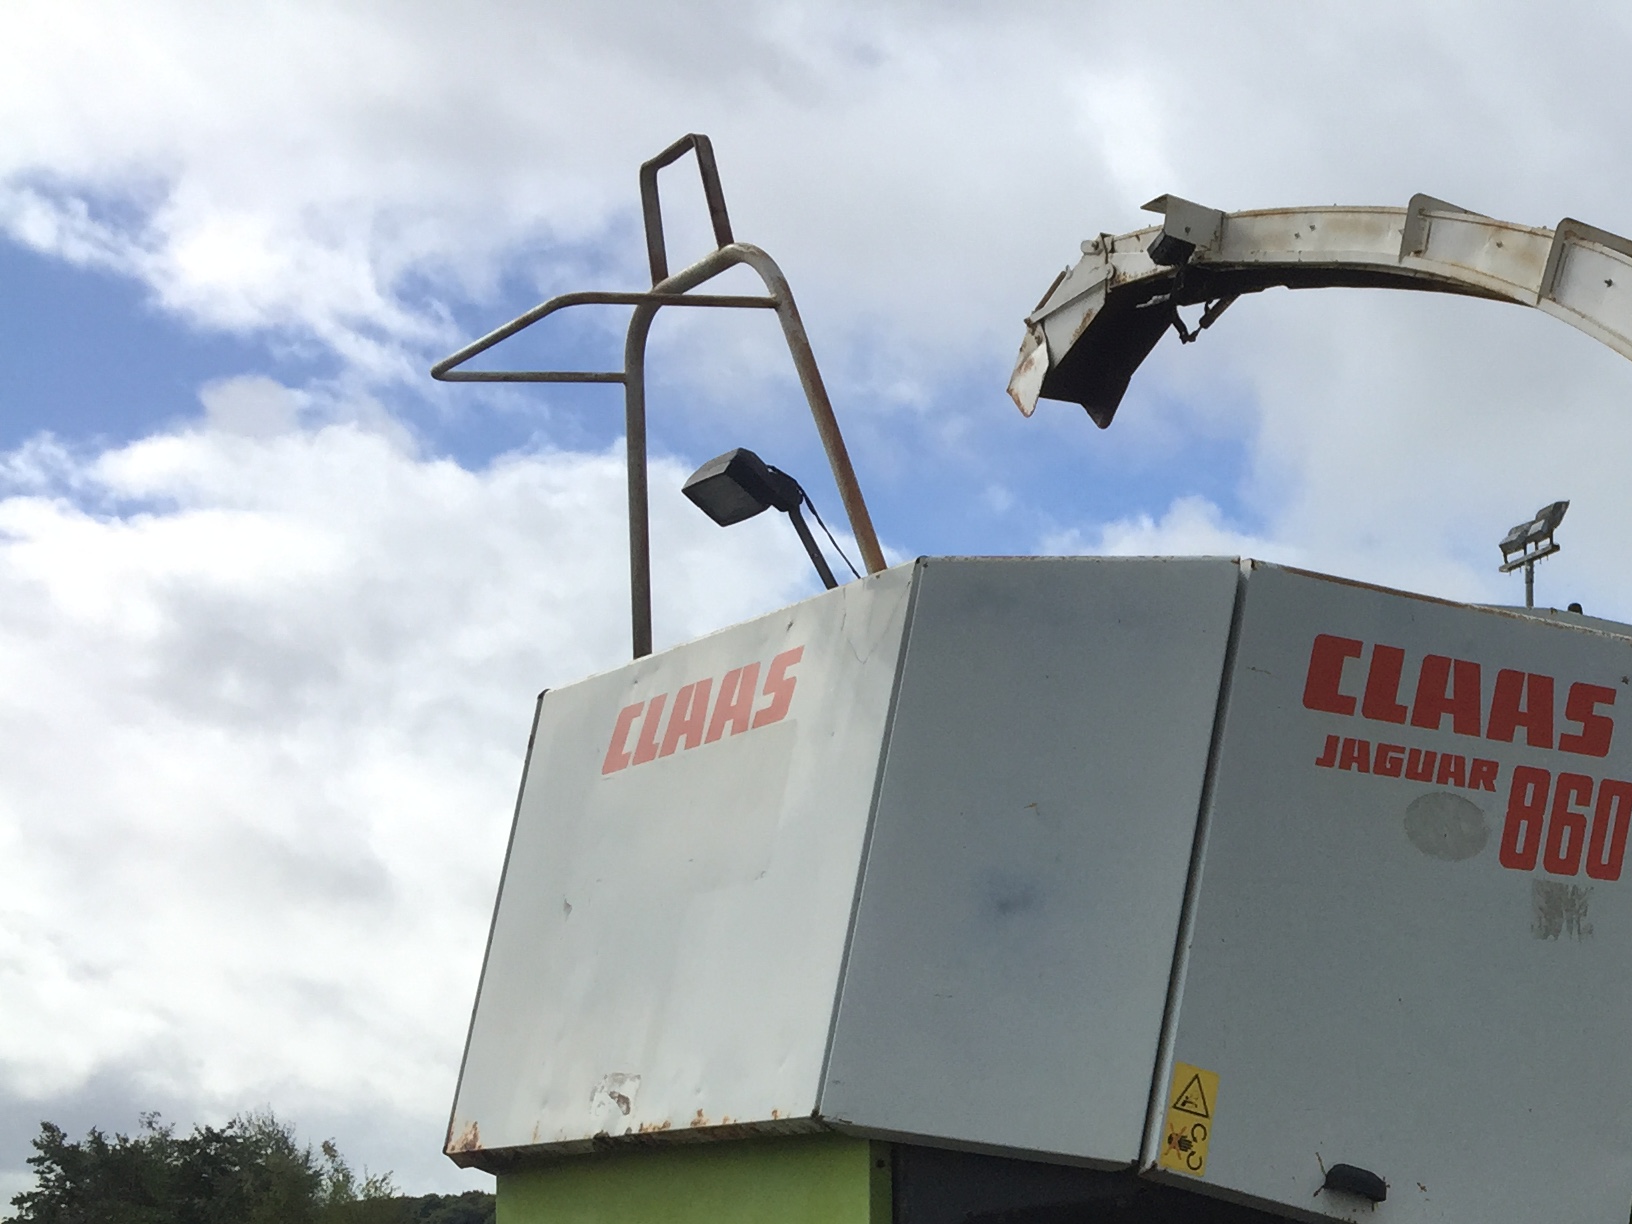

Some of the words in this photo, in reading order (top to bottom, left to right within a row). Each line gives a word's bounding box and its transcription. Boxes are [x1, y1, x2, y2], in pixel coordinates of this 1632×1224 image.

[602, 645, 804, 775] CLAAS
[1303, 634, 1616, 757] CLAAS
[1315, 735, 1499, 792] JAGUAR
